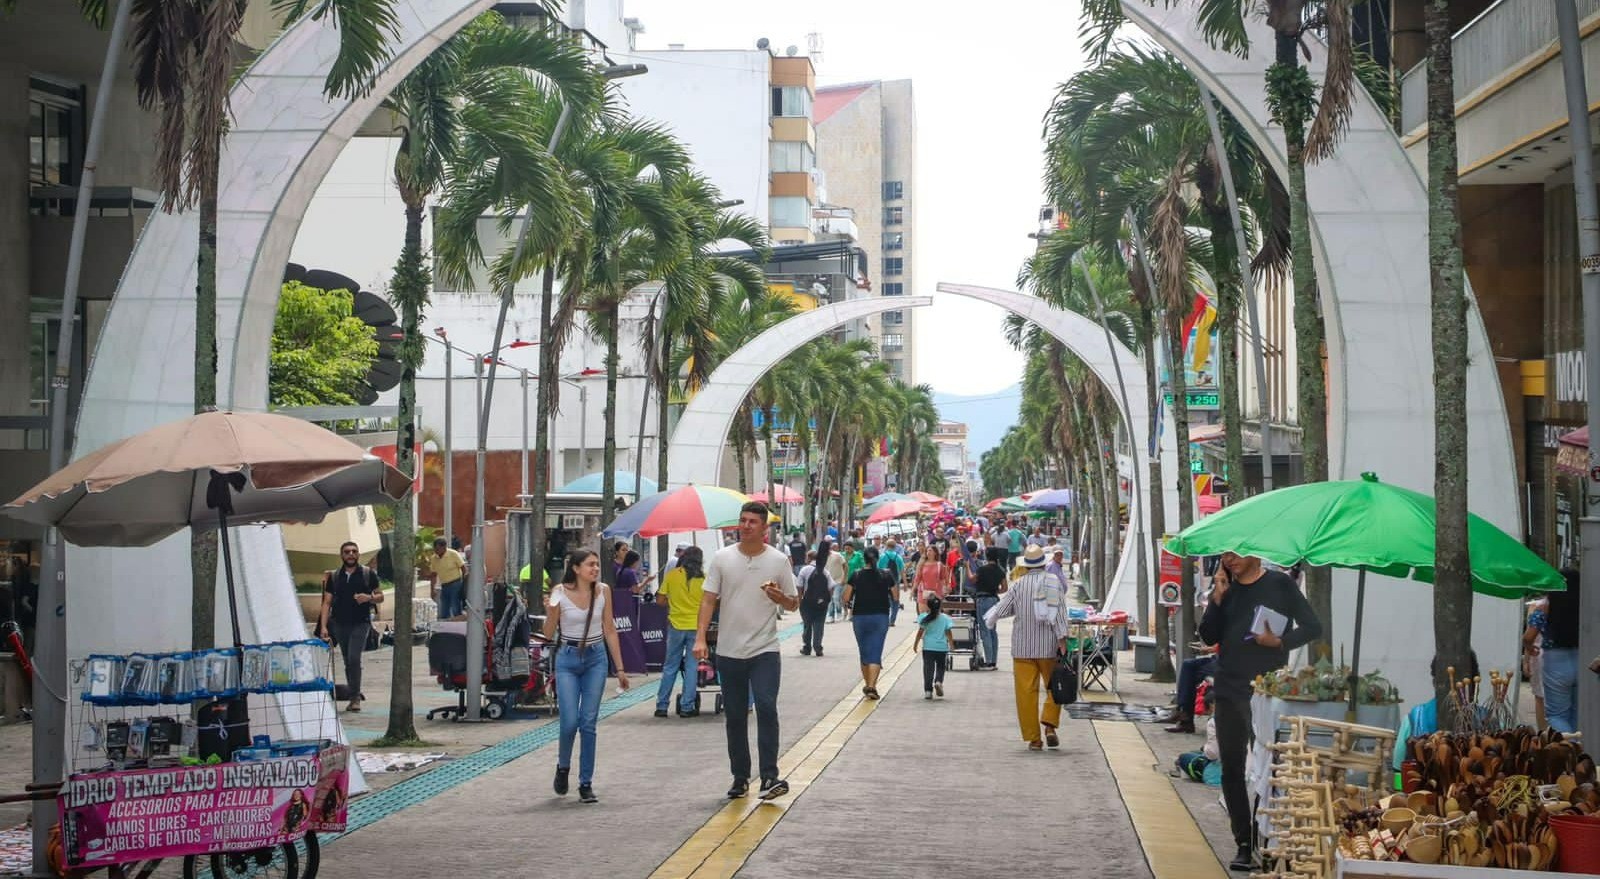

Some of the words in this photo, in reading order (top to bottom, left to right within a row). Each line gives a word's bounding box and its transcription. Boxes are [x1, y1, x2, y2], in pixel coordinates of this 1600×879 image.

[641, 630, 664, 640] WOM
[122, 767, 217, 799] TEMPLADO
[222, 760, 319, 789] INSTALADO
[108, 798, 182, 819] ACCESORIOS
[184, 793, 214, 811] PARA
[217, 789, 269, 807] CELULAR
[106, 820, 145, 836] MANOS
[149, 815, 187, 832] LIBRES
[200, 807, 273, 827] CARGADORES
[104, 834, 145, 852] CABLES
[149, 832, 162, 848] DE
[166, 829, 201, 845] DATOS
[213, 822, 273, 840] MEMORIAS
[208, 842, 220, 851] LA
[222, 838, 267, 851] MORENITA
